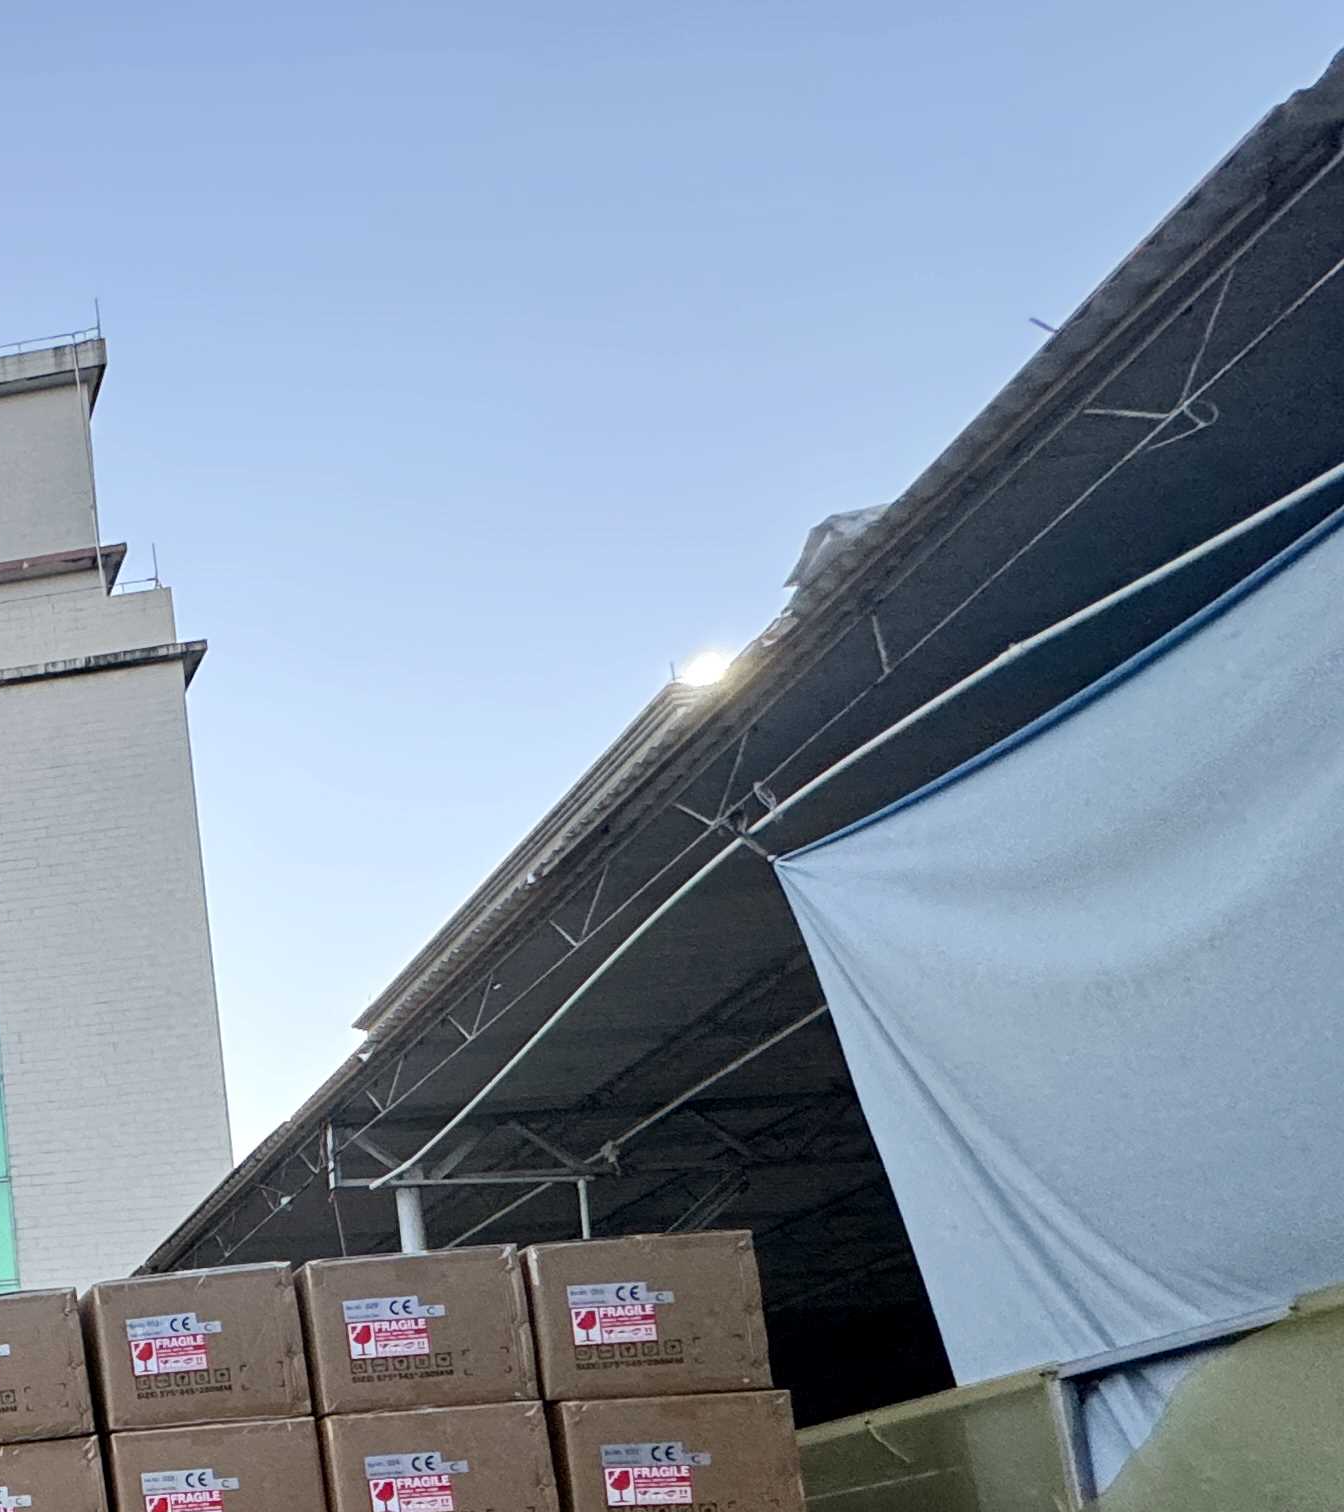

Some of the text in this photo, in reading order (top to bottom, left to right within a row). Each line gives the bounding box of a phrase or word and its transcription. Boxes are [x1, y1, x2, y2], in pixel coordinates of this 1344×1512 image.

[616, 1286, 640, 1301] CE
[390, 1300, 412, 1315] CE
[599, 1304, 654, 1318] FRAGILE
[170, 1317, 190, 1332] CE
[376, 1319, 426, 1332] FRAGILE
[156, 1334, 204, 1349] FRAGILE
[651, 1446, 675, 1462] CE
[412, 1456, 435, 1472] CE
[632, 1464, 689, 1478] FRAGILE
[186, 1472, 207, 1487] CE
[397, 1474, 449, 1489] FRAGILE
[170, 1489, 219, 1505] FRAGILE
